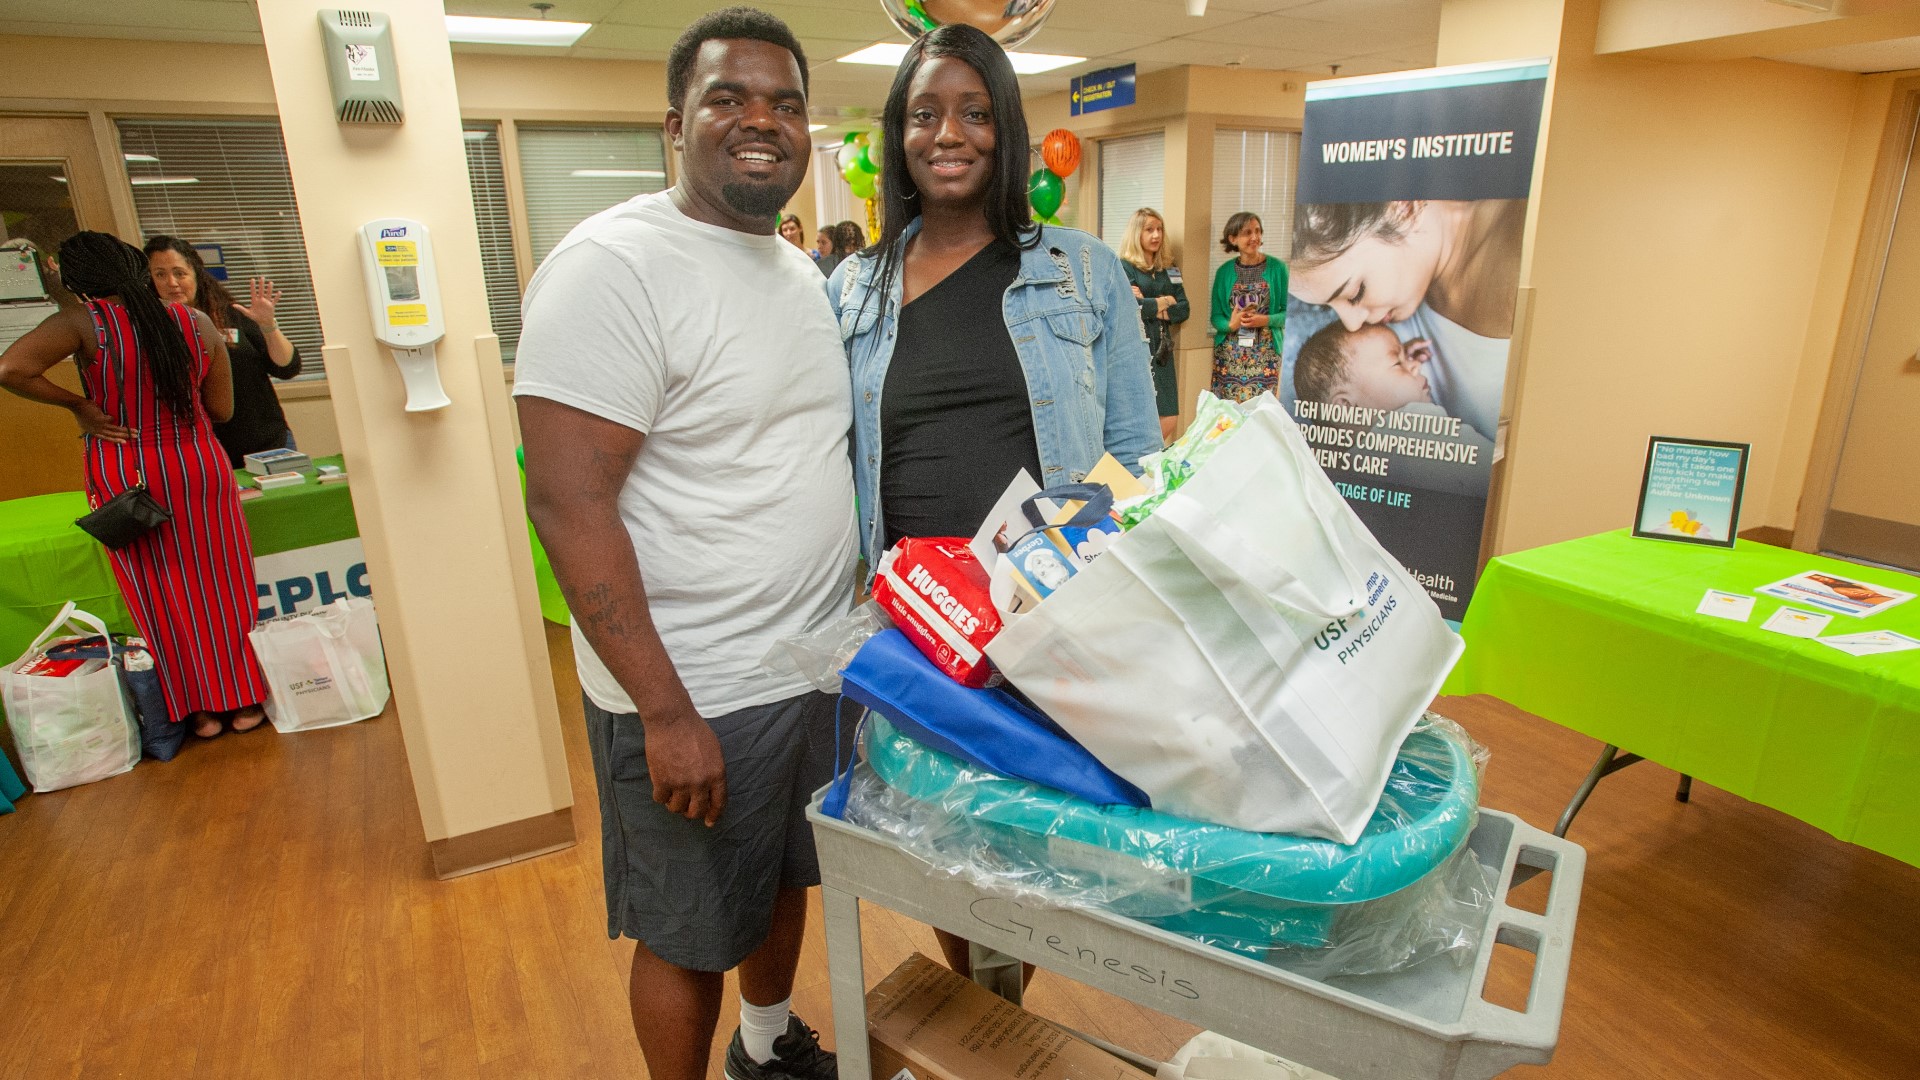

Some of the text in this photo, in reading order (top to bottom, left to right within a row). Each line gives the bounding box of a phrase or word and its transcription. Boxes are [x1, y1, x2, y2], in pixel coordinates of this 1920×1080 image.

[1322, 131, 1514, 164] WOMEN'S INSTITUTE
[1294, 400, 1462, 437] TGH WOMEN'S INSTITUTE
[1356, 431, 1478, 464] COMPREHENSIVE
[1676, 448, 1707, 456] matter
[1709, 450, 1730, 458] how
[1692, 456, 1716, 465] day's
[1353, 454, 1389, 476] CARE
[1653, 475, 1720, 487] everything feel
[1335, 482, 1412, 508] STAGE OF LIFE
[1650, 488, 1730, 503] Author Unknown
[906, 563, 980, 636] HUGGIES
[1368, 575, 1390, 606] General
[1430, 590, 1458, 602] Medicine
[892, 598, 907, 617] little
[1314, 618, 1348, 650] USF
[1337, 595, 1397, 665] PHYSICIANS
[289, 681, 303, 690] USF
[295, 684, 330, 695] PHYSICIANS
[970, 898, 1200, 1000] Genesis
[1012, 1043, 1044, 1080] Washington
